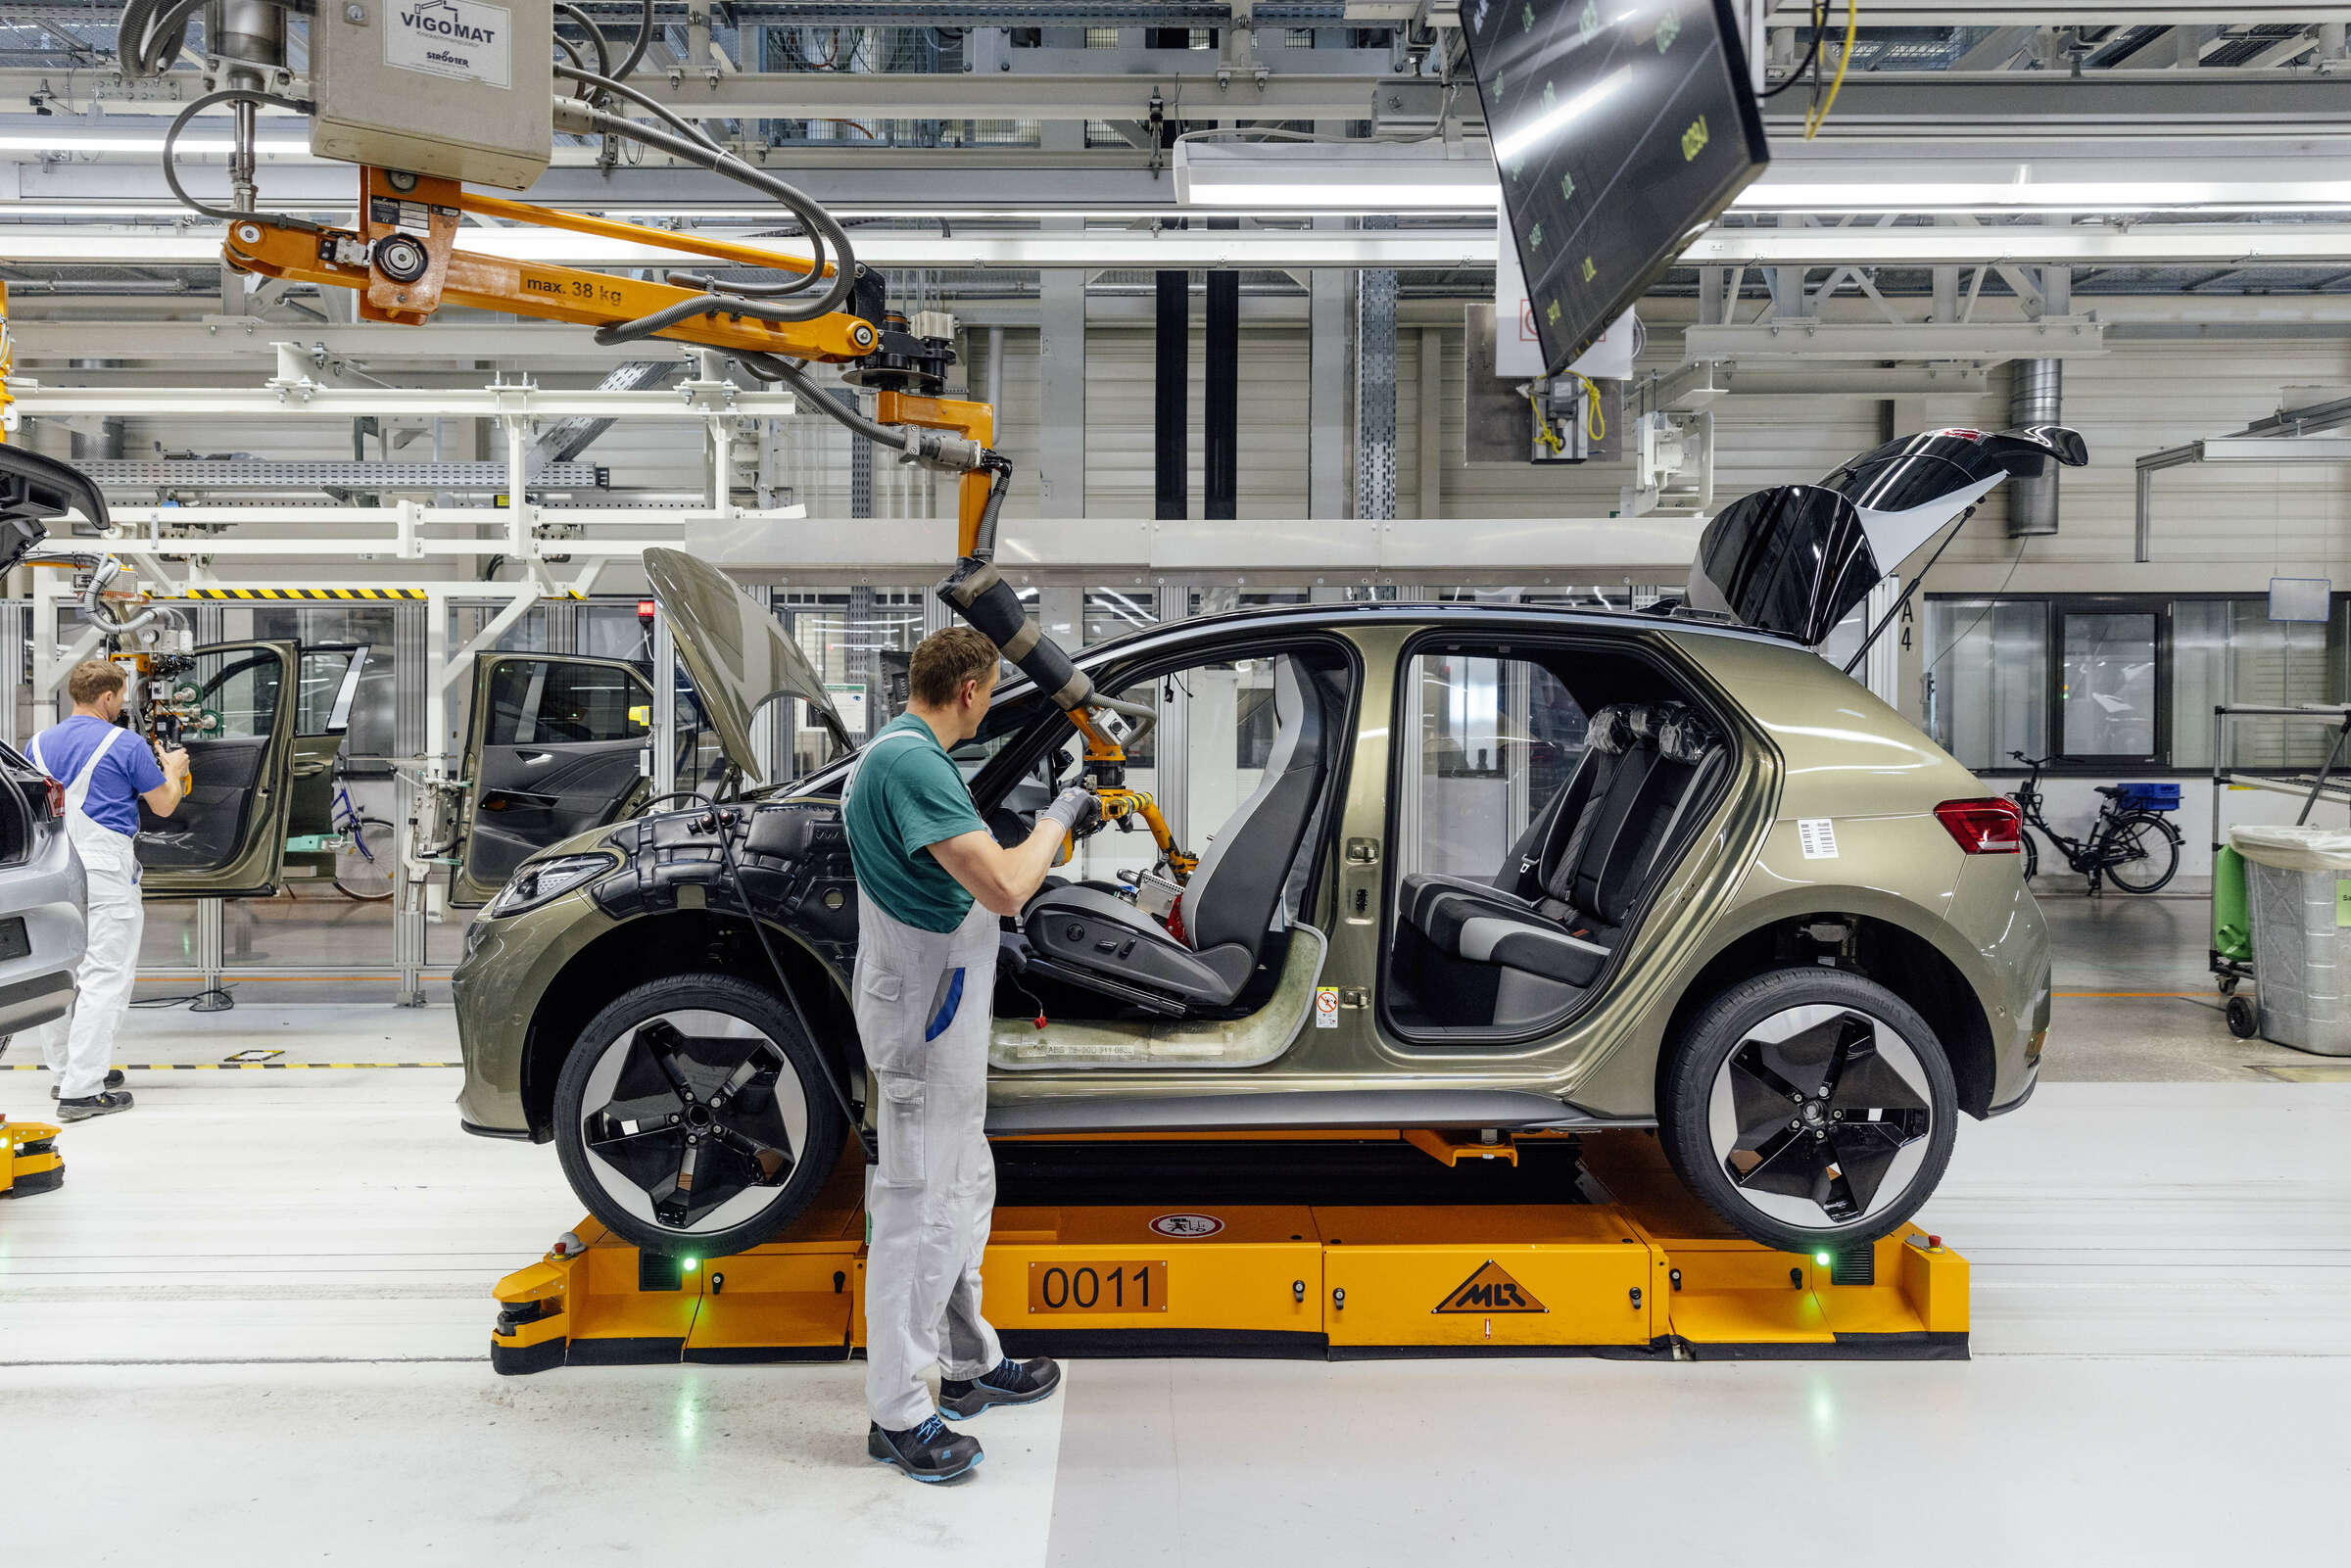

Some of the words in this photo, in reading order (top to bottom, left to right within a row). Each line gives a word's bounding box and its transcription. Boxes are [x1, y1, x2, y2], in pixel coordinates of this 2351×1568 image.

[401, 12, 495, 44] VIGOMAT
[527, 278, 566, 295] max.
[572, 281, 594, 299] 38
[600, 285, 621, 307] kg
[1042, 1266, 1149, 1308] 0011
[1456, 1283, 1526, 1307] MLR
